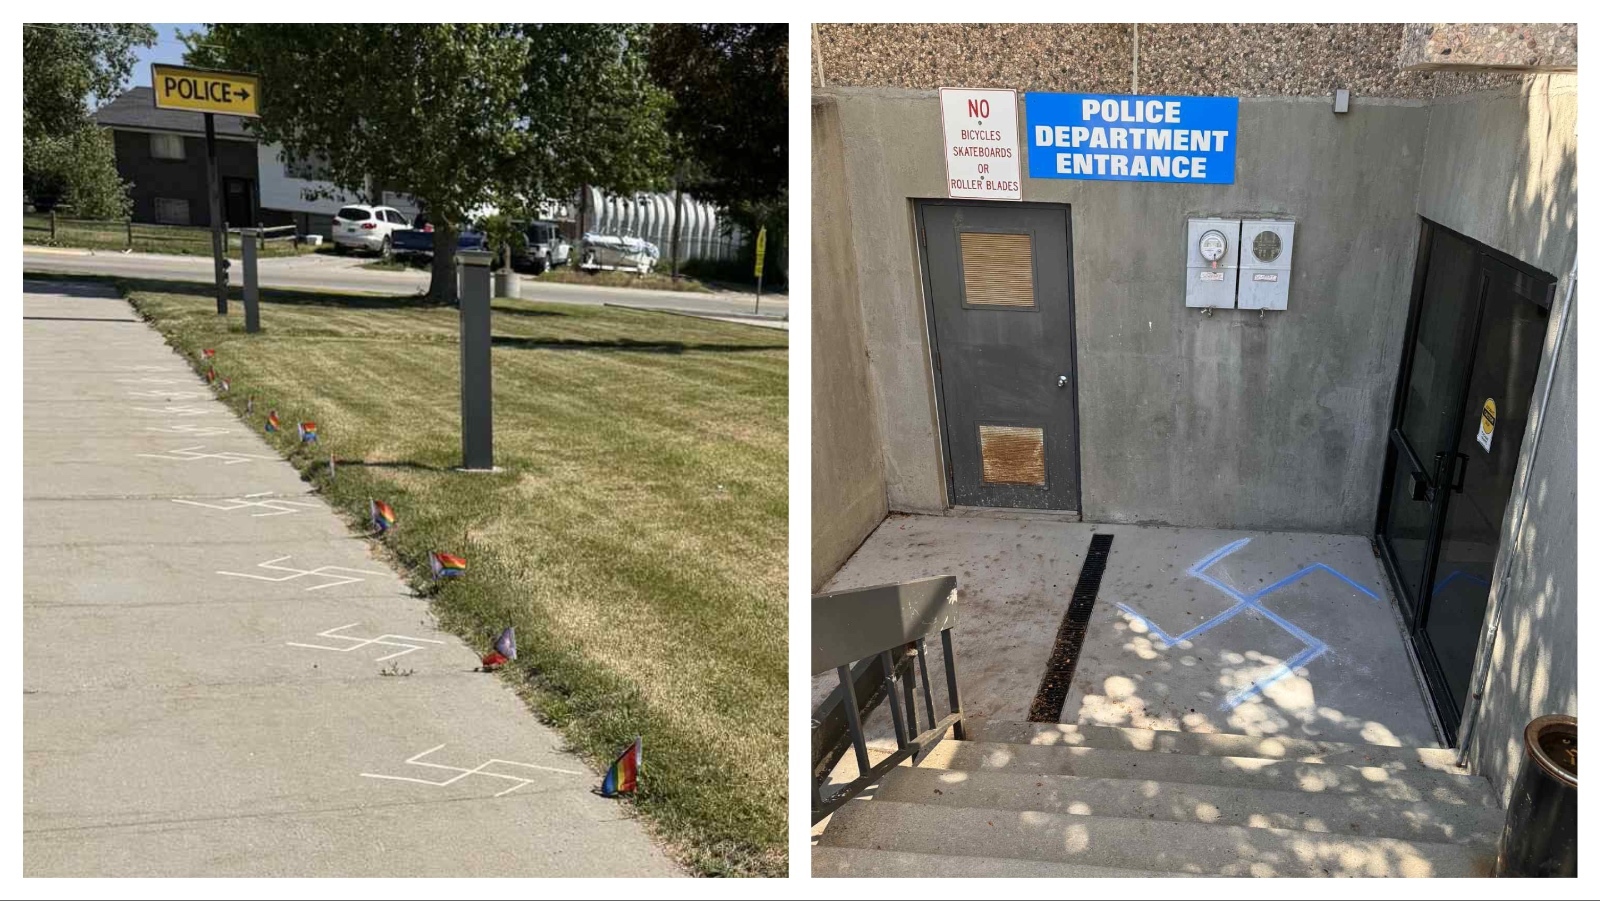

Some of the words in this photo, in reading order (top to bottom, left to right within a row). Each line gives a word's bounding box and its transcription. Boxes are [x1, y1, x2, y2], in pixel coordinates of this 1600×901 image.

[164, 76, 232, 103] POLICE
[968, 99, 990, 119] NO
[1082, 99, 1181, 124] POLICE
[961, 129, 1001, 141] BICYCLES
[1035, 125, 1229, 152] DEPARTMENT
[953, 146, 1012, 158] SKATEBOARDS
[977, 163, 989, 174] OR
[1056, 152, 1207, 179] ENTRANCE
[951, 178, 983, 190] ROLLER
[986, 180, 1019, 192] BLADES
